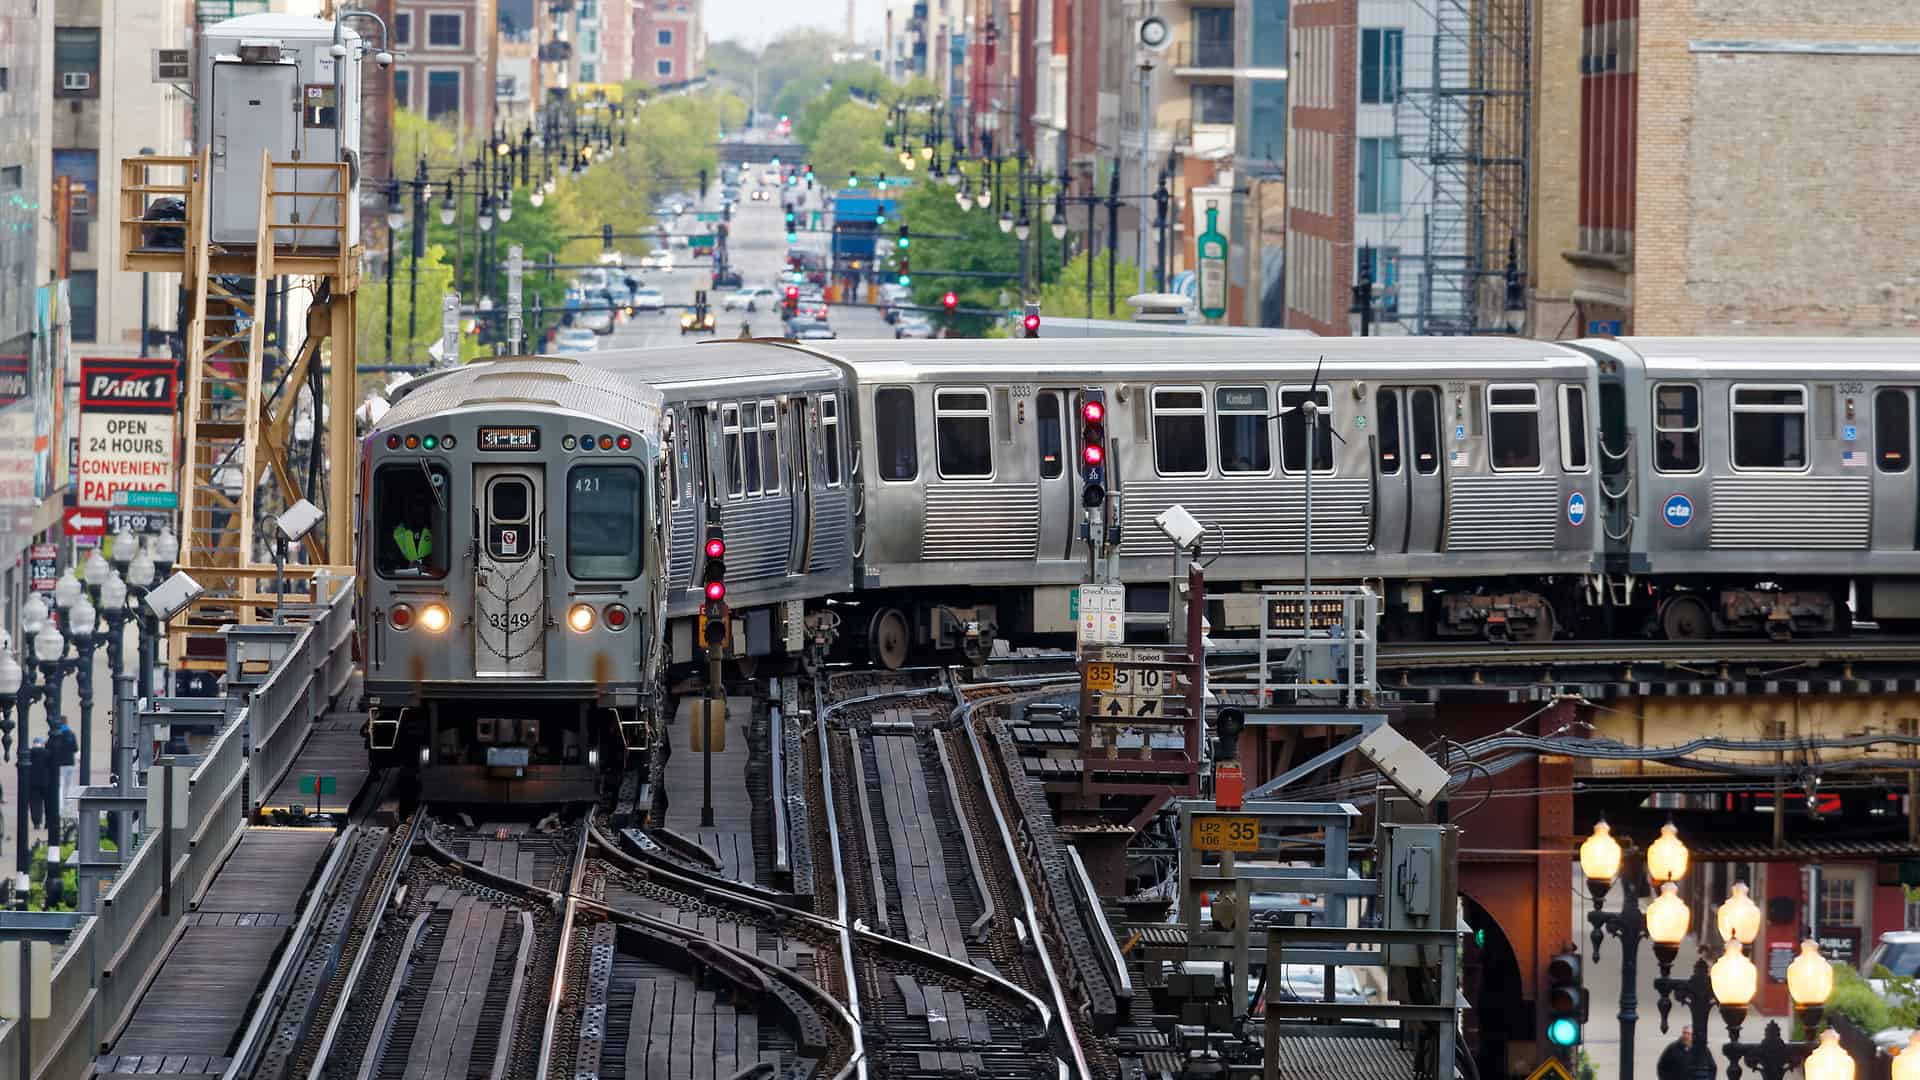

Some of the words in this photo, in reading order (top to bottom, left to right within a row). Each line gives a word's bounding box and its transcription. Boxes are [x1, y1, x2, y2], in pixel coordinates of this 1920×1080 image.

[91, 376, 150, 398] PARK
[154, 377, 166, 398] 1
[107, 420, 147, 434] OPEN
[89, 438, 107, 452] 24
[111, 438, 164, 454] HOURS
[81, 459, 170, 476] CONVENIENT
[575, 477, 600, 492] 421
[1569, 503, 1584, 514] cta
[1667, 505, 1690, 517] cta
[489, 613, 530, 627] 3349
[1137, 653, 1160, 662] Speed
[1090, 666, 1111, 681] 35
[1137, 670, 1158, 687] 10
[1200, 823, 1220, 832] LP2
[1229, 822, 1255, 840] 35
